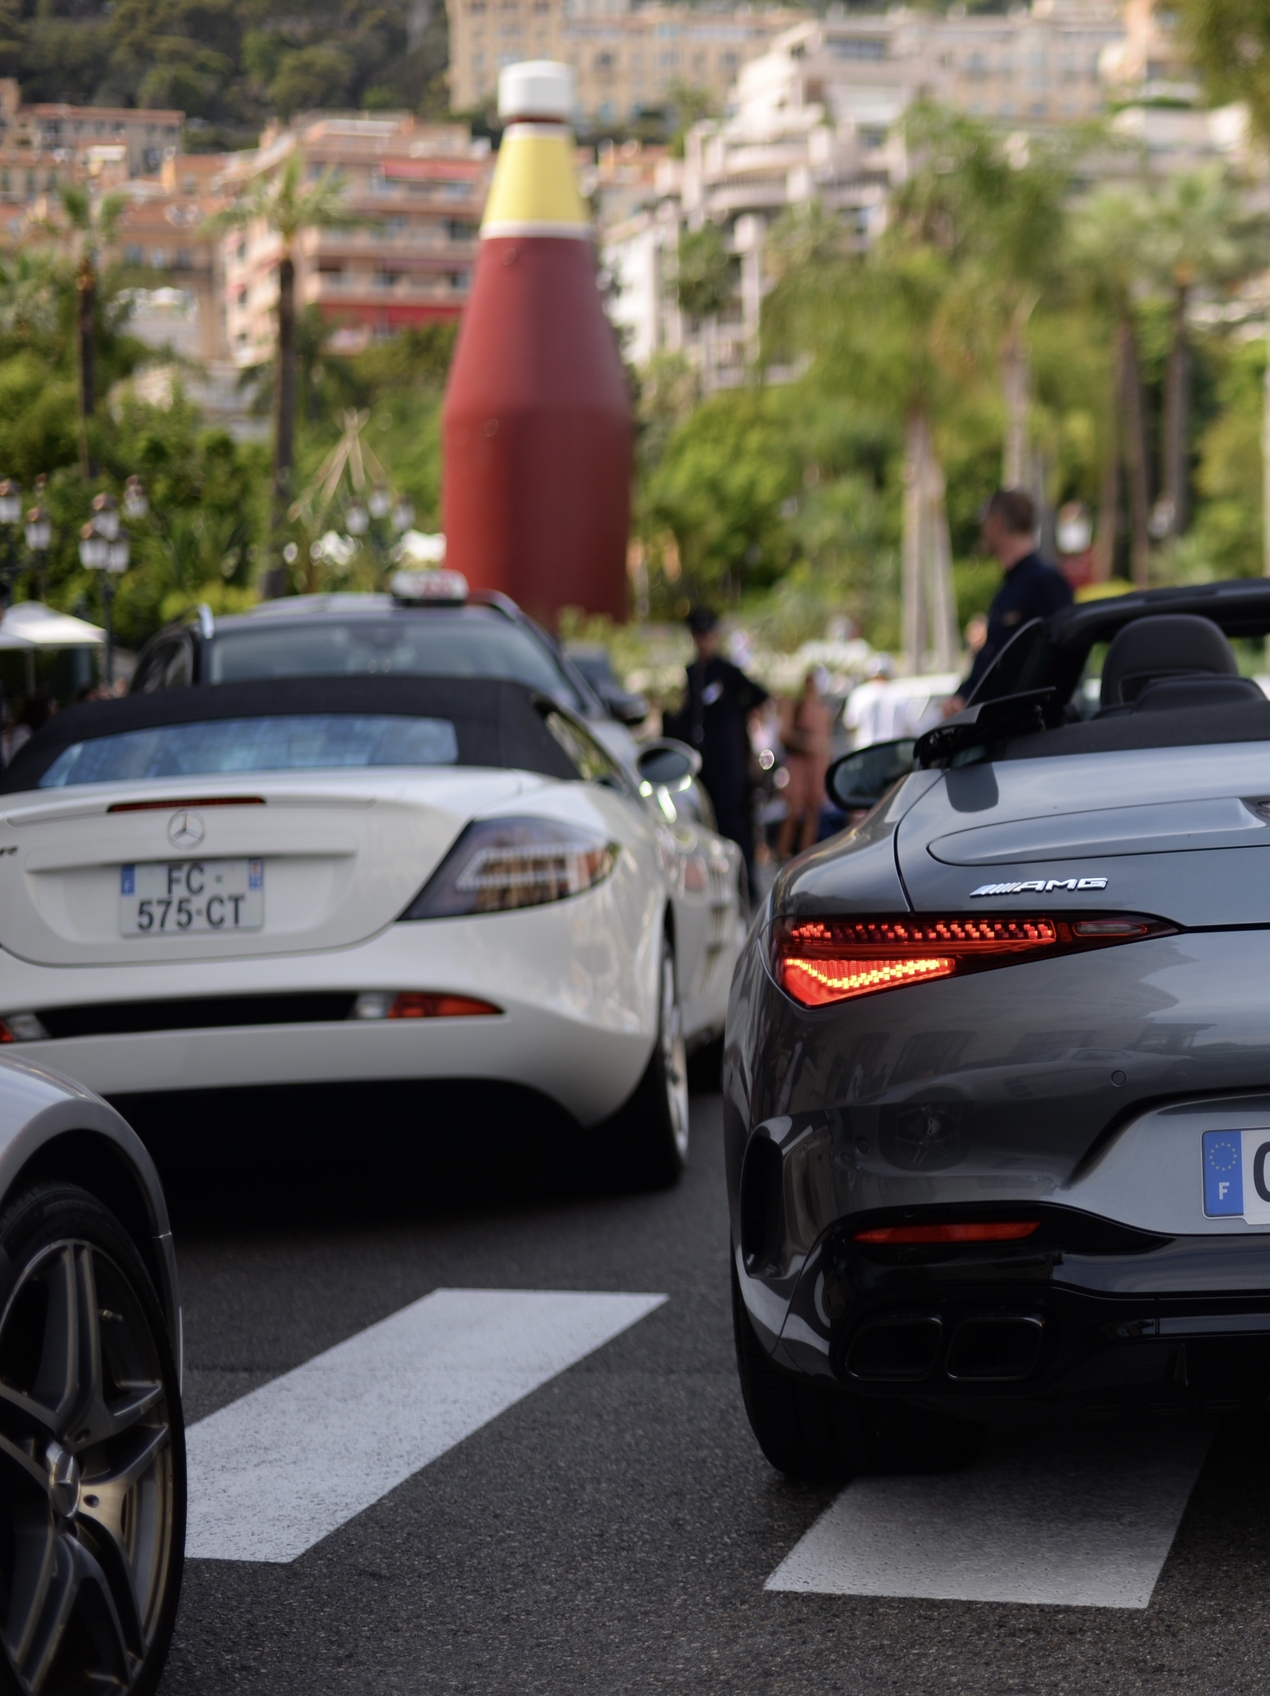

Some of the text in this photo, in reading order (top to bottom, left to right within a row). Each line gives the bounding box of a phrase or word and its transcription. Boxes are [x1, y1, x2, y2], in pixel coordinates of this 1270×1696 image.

[1011, 877, 1108, 893] AMG
[137, 894, 246, 932] 575-CT
[1218, 1182, 1230, 1200] F
